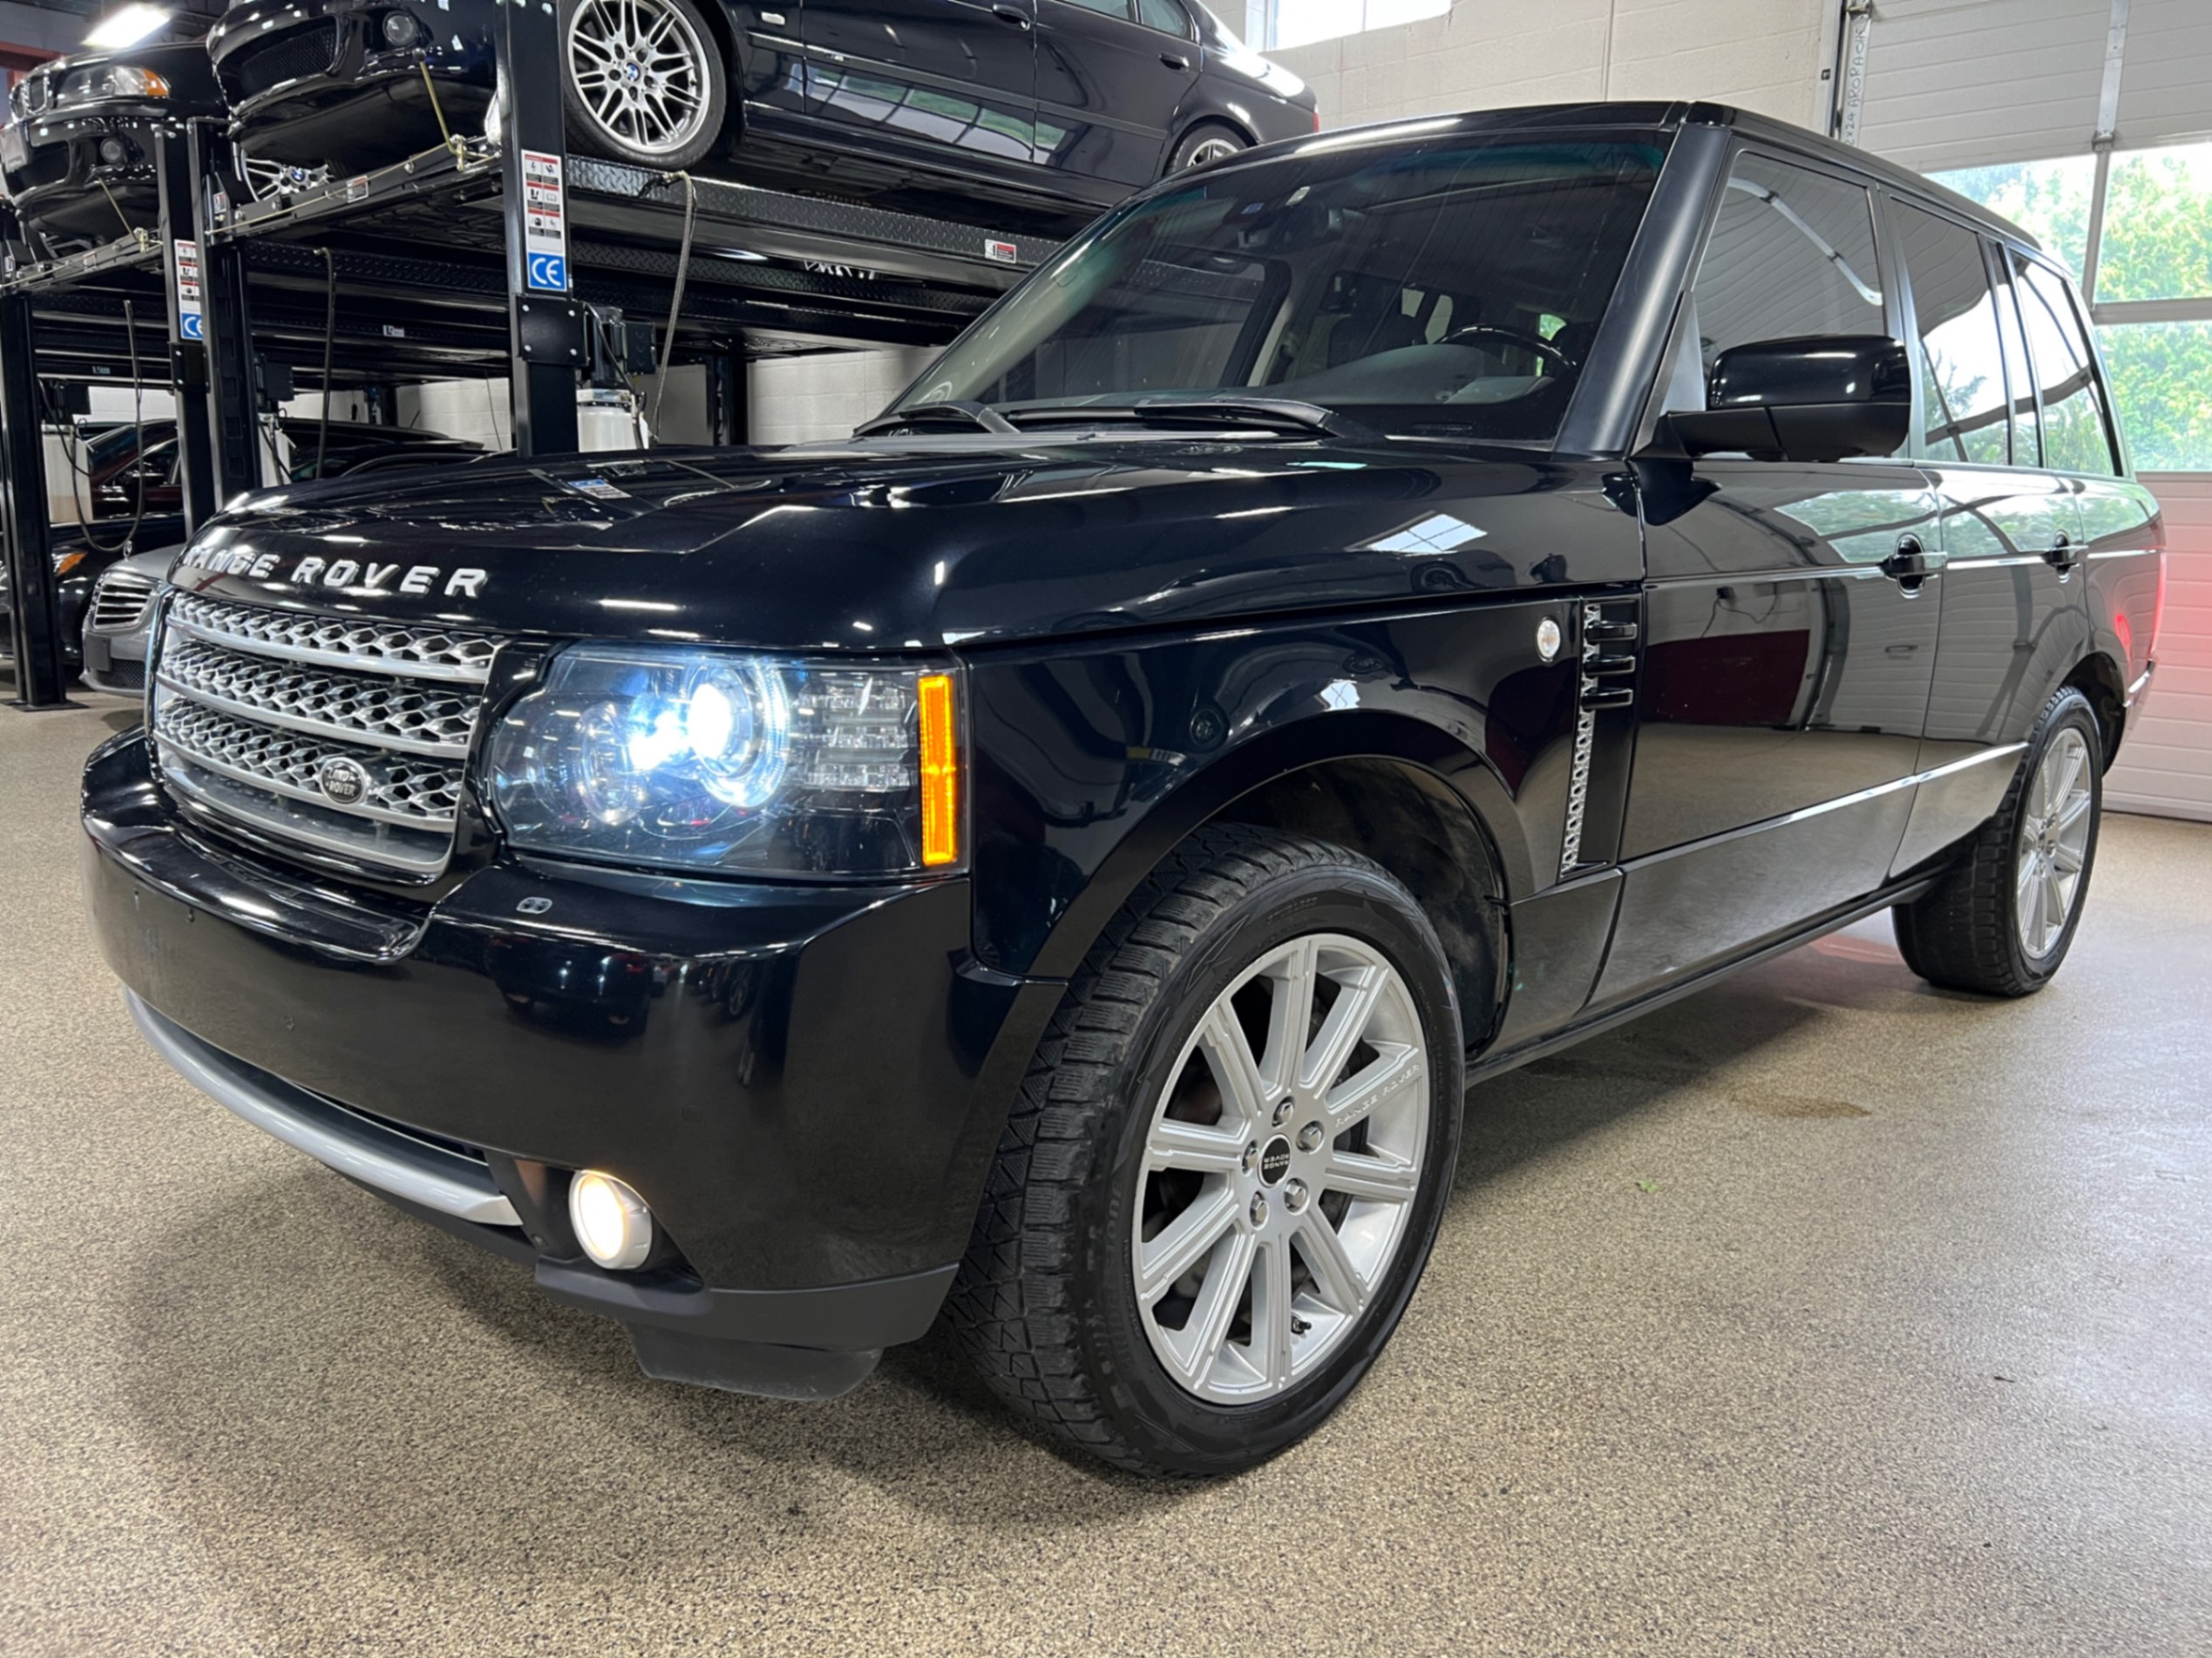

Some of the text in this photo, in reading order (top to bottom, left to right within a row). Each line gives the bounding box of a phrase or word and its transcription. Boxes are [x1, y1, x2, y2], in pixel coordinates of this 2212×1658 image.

[532, 257, 562, 287] CE
[182, 545, 488, 598] RANGE ROVER
[329, 780, 356, 797] ROVER
[1382, 1064, 1421, 1096] ROVER
